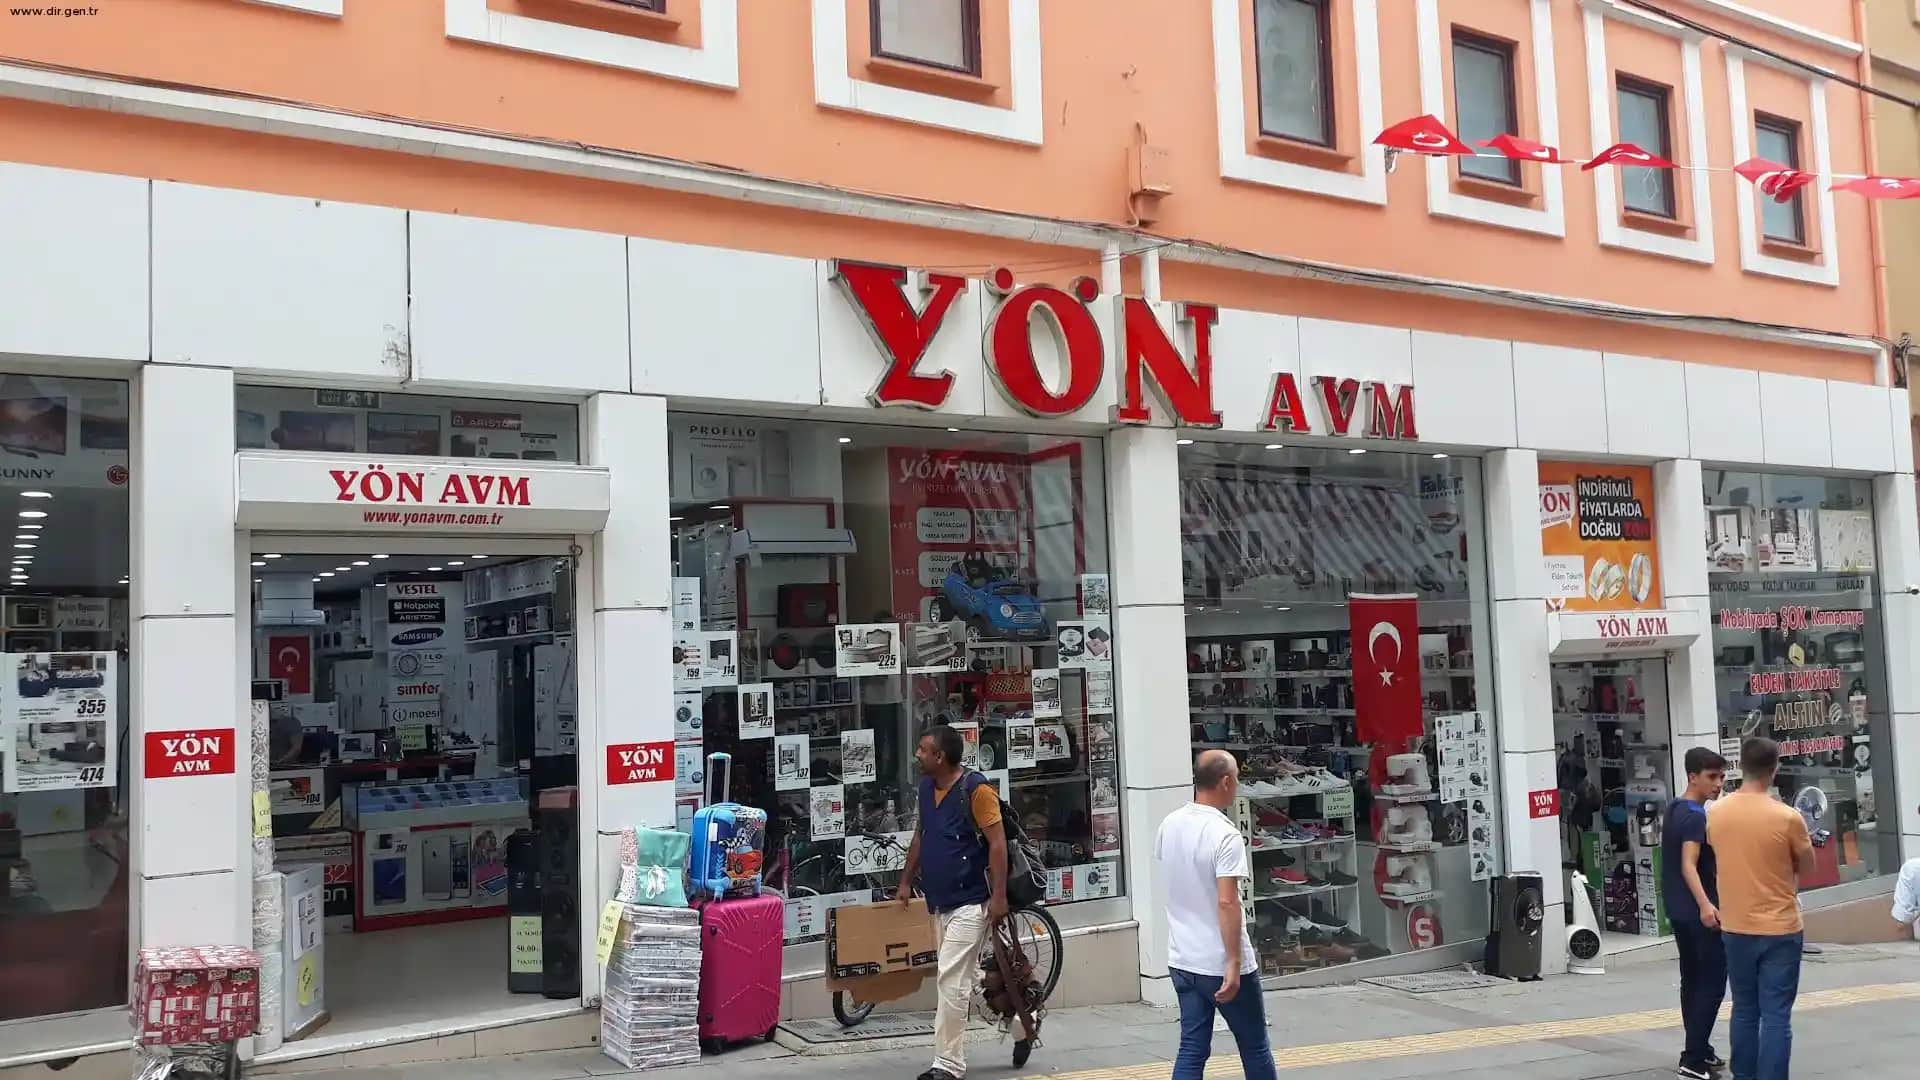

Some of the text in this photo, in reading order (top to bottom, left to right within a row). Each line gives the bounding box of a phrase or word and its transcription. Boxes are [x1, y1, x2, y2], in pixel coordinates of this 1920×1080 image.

[827, 258, 1420, 440] YÖN AVM
[329, 463, 532, 506] YÖN AVM
[1578, 478, 1632, 497] İNDİRİMLİ
[1540, 487, 1570, 513] ÖN
[1580, 498, 1642, 517] FİYATLARDA
[363, 508, 504, 527] www.yonavm.com.tr
[1581, 519, 1621, 537] DOĞRU
[395, 583, 439, 595] VESTEL
[1597, 614, 1669, 638] YÖN AVM
[1720, 607, 1778, 633] Mobilyada
[1811, 607, 1865, 629] Kampanya
[878, 654, 897, 667] 225
[949, 656, 966, 669] 168
[686, 667, 700, 678] 159
[396, 681, 440, 696] simfer
[1750, 671, 1786, 696] ELDEN
[77, 699, 107, 715] 355
[1773, 699, 1825, 732] ALTIN
[160, 733, 222, 757] YÖN
[618, 745, 664, 767] YÖN
[79, 767, 105, 782] 474
[172, 760, 211, 774] AVM
[627, 767, 657, 780] AVM
[304, 793, 321, 805] 104
[1533, 792, 1554, 806] YÖN
[876, 854, 888, 866] 69
